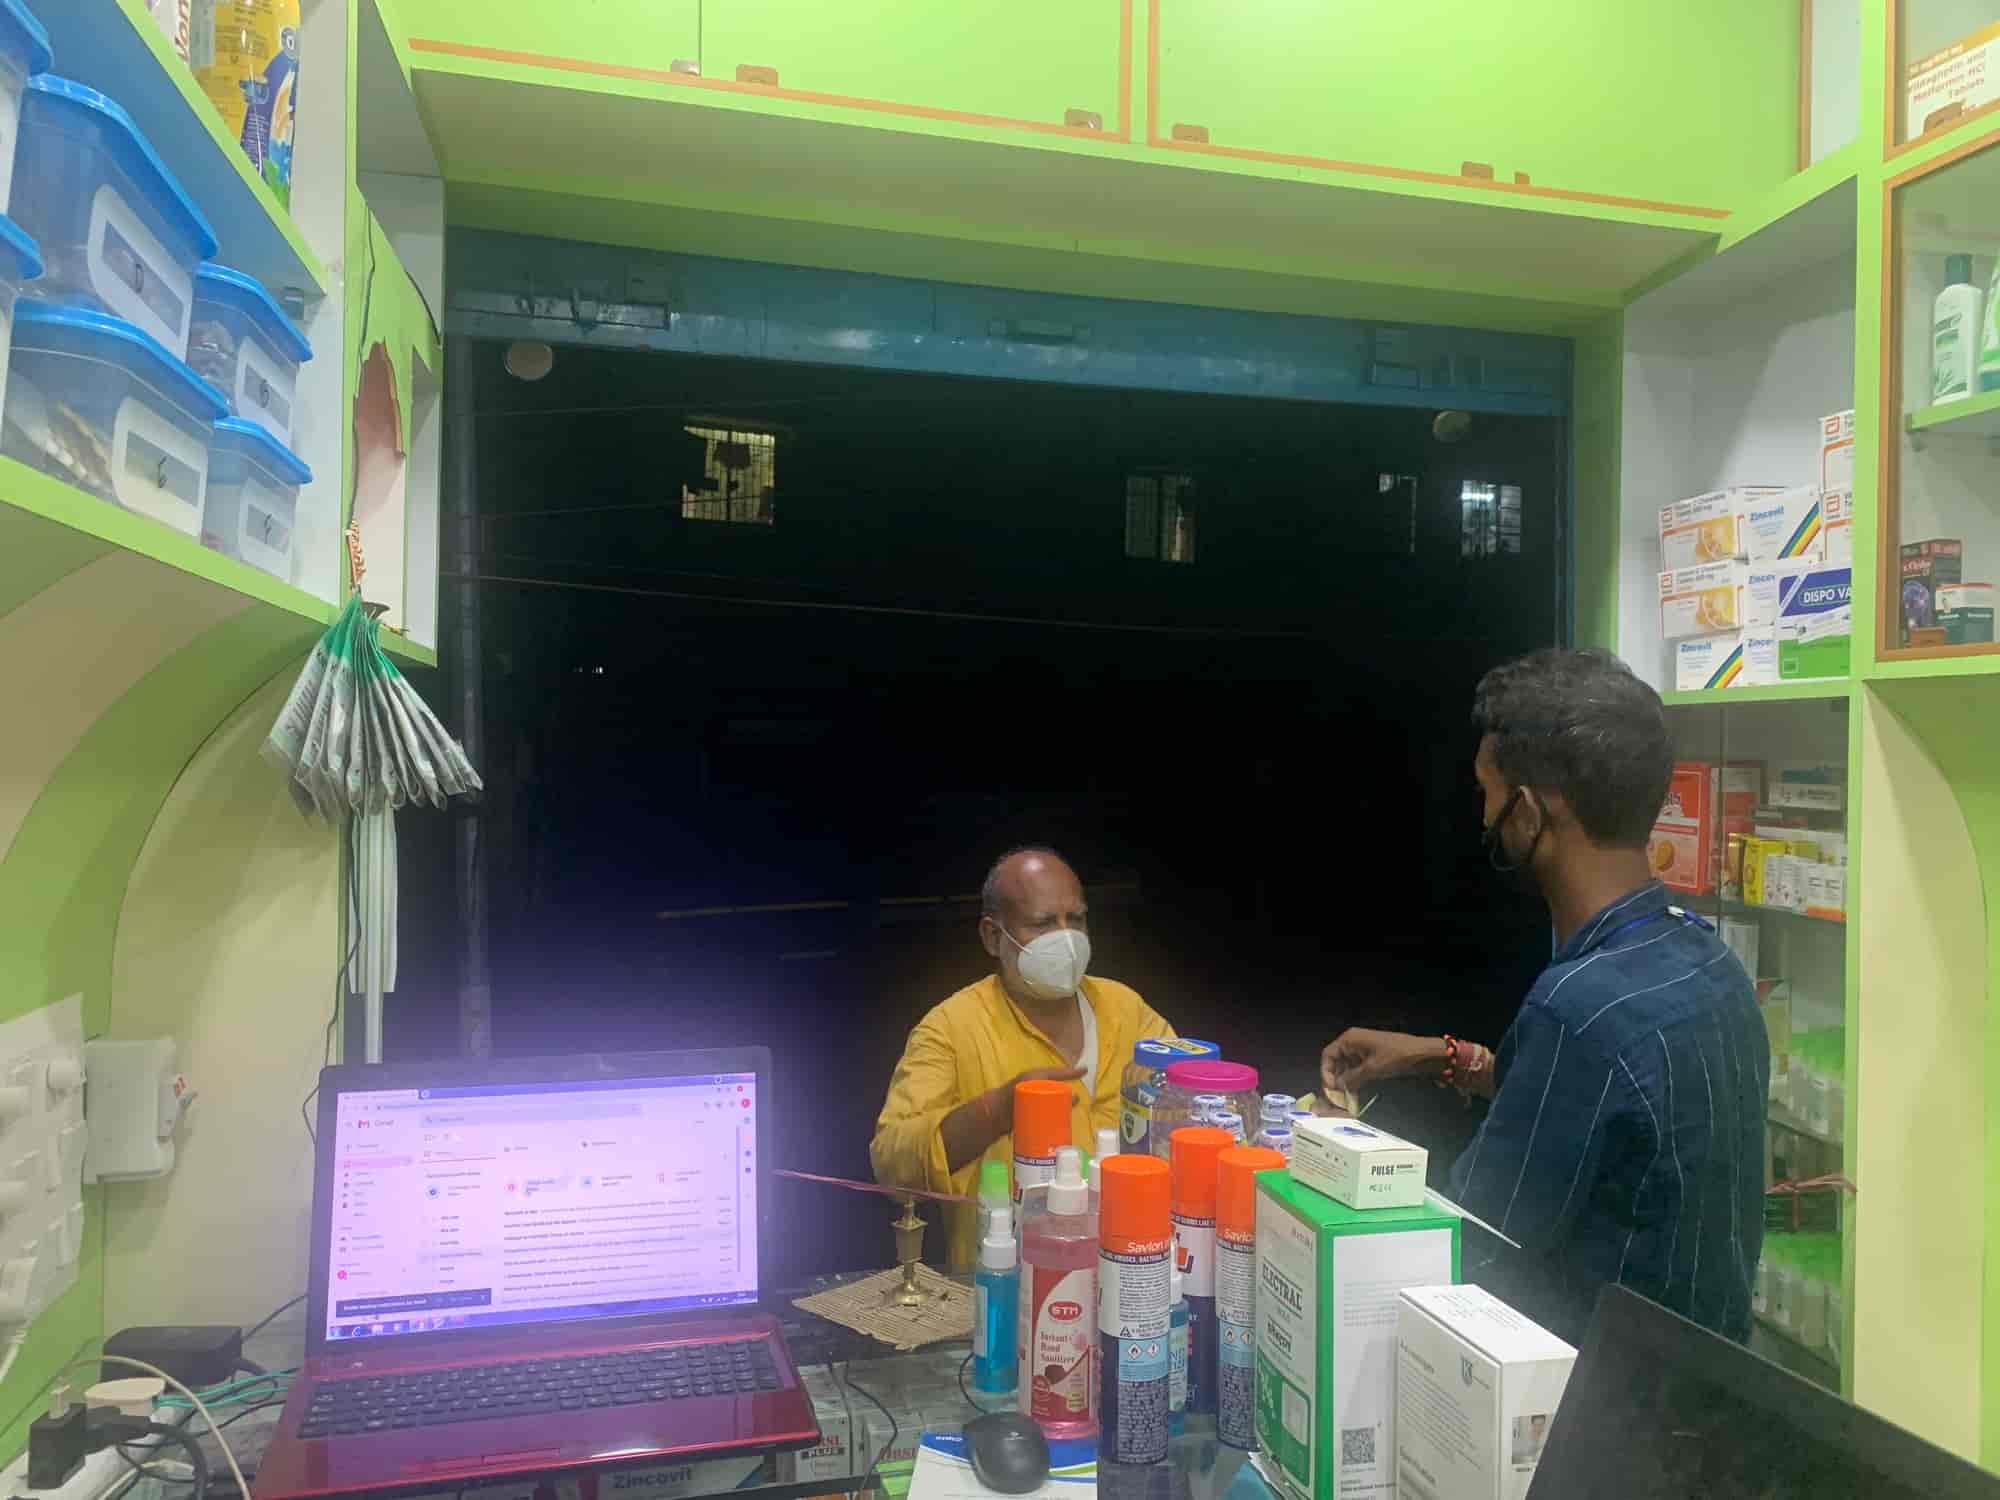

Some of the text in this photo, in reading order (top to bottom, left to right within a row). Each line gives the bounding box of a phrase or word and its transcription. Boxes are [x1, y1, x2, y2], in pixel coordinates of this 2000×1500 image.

[1803, 587, 1852, 604] DISPO VA
[1371, 1165, 1394, 1176] PULSE
[1127, 1241, 1164, 1254] Savlon
[1262, 1263, 1302, 1311] ELECTRAL
[612, 1465, 692, 1489] Zincovit
